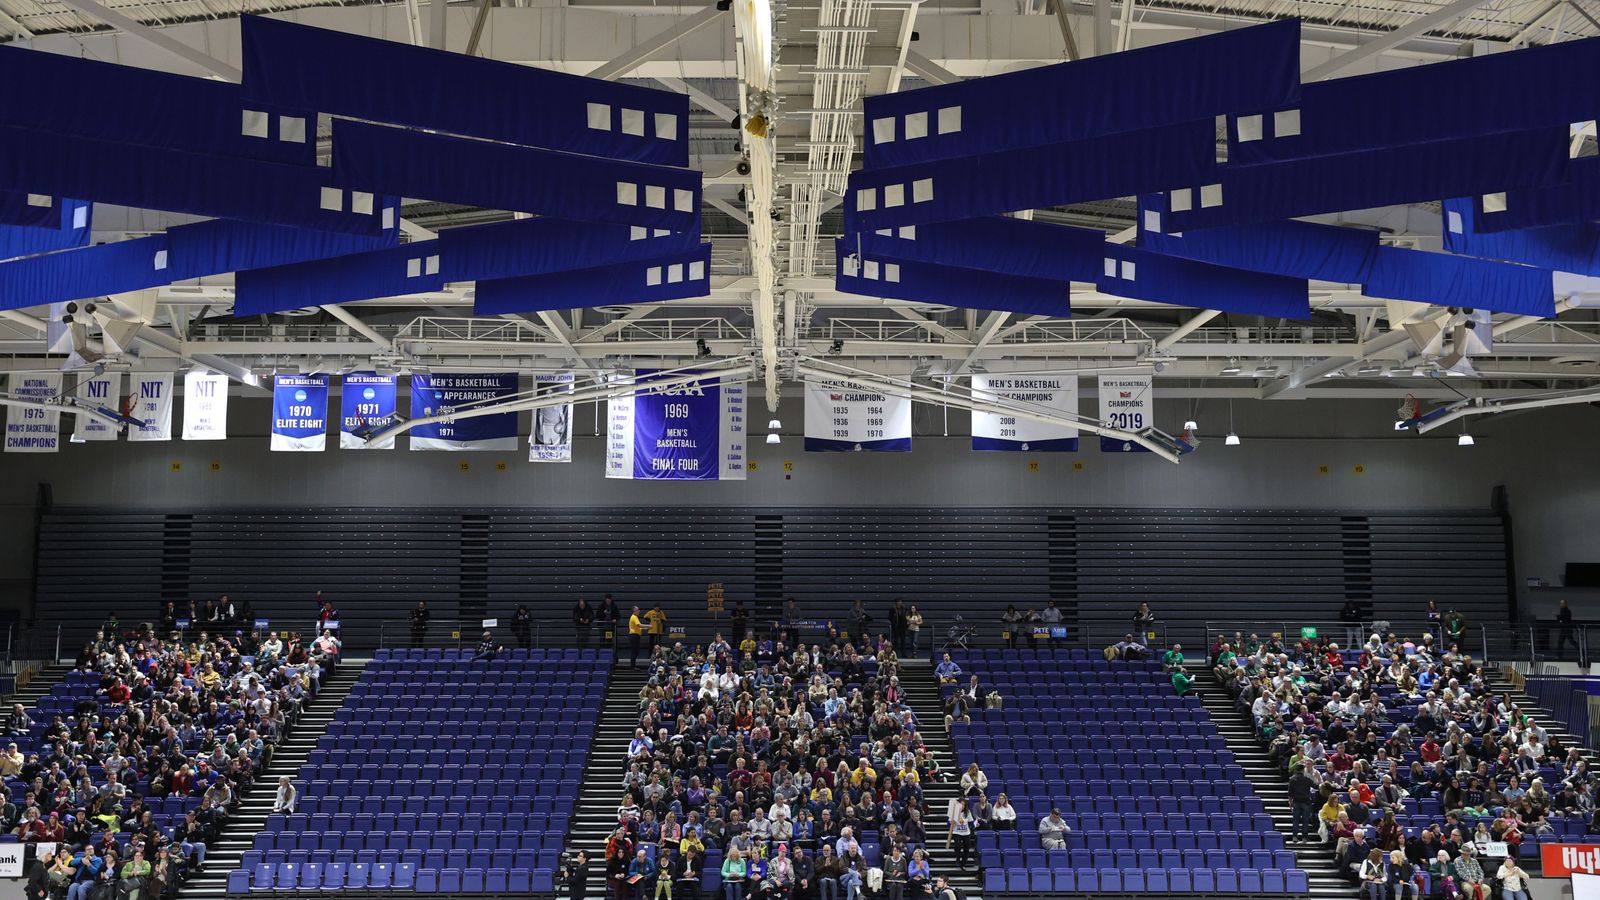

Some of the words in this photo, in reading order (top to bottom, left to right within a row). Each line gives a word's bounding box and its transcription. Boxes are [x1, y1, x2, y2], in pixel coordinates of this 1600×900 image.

[24, 379, 48, 387] NATIONAL
[430, 378, 453, 387] MEN'S
[456, 379, 500, 387] BASKETBALL
[989, 380, 1012, 388] MEN'S
[1015, 380, 1060, 388] BASKETBALL
[15, 388, 56, 396] COMMISSIONERS
[88, 381, 110, 398] NIT
[140, 382, 163, 398] NIT
[196, 381, 217, 397] NIT
[444, 392, 496, 400] APPEARANCES
[24, 409, 44, 418] 1975
[289, 406, 312, 416] 1970
[358, 404, 378, 414] 1971
[665, 404, 689, 418] 1969
[276, 419, 298, 428] ELITE
[300, 419, 323, 428] EIGHT
[1110, 413, 1142, 429] 2019
[8, 424, 24, 432] MEN'S
[26, 424, 56, 432] BASKETBALL
[667, 429, 688, 437] MEN'S
[8, 437, 56, 448] CHAMPIONS
[657, 440, 697, 448] BASKETBALL
[652, 459, 675, 470] FINAL
[678, 459, 699, 470] FOUR
[1562, 847, 1600, 874] Hy
